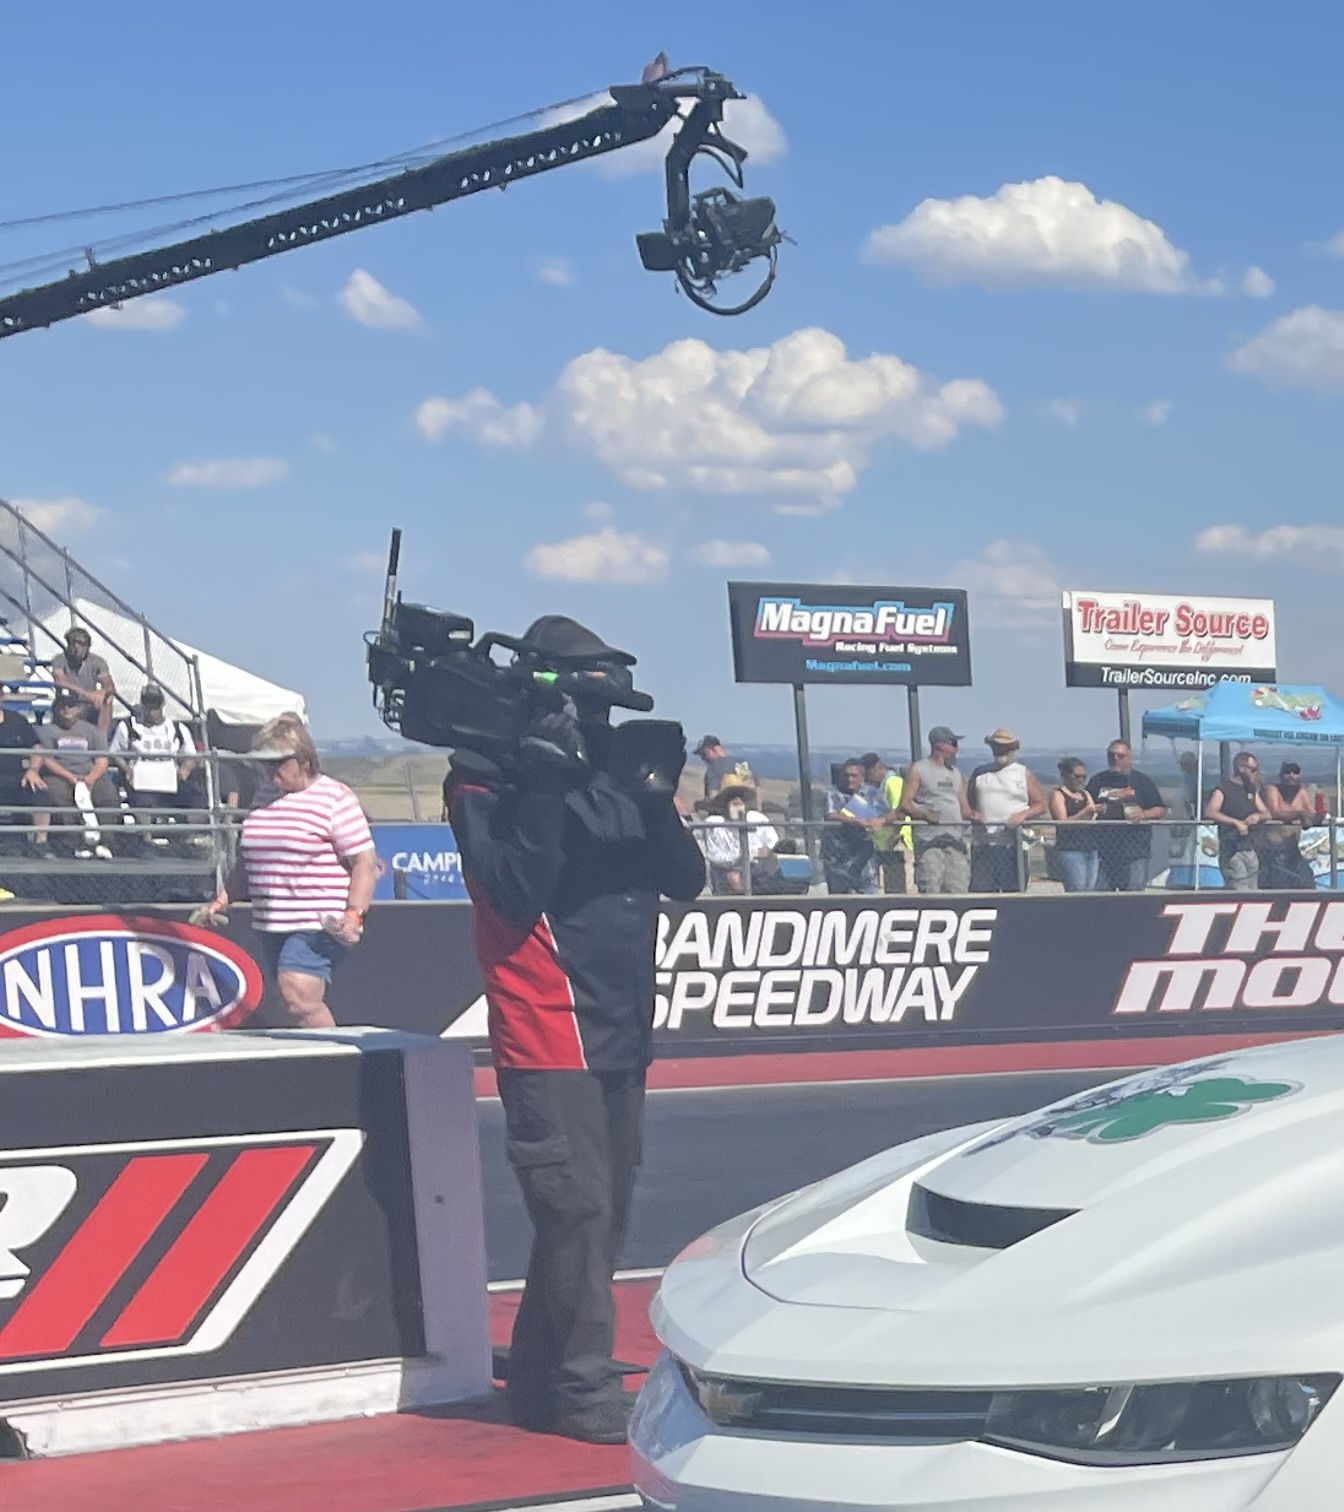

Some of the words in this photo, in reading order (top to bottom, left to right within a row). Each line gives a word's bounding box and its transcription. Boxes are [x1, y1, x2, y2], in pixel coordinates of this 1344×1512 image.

[760, 602, 947, 641] MagnaFuel
[1078, 600, 1168, 636] Trailer
[1175, 603, 1269, 640] Source
[835, 641, 876, 654] Racing
[879, 641, 904, 653] Fuel
[907, 643, 958, 655] Systems
[1101, 666, 1252, 687] TrailerSourceInccom
[2, 940, 223, 1034] NHRA
